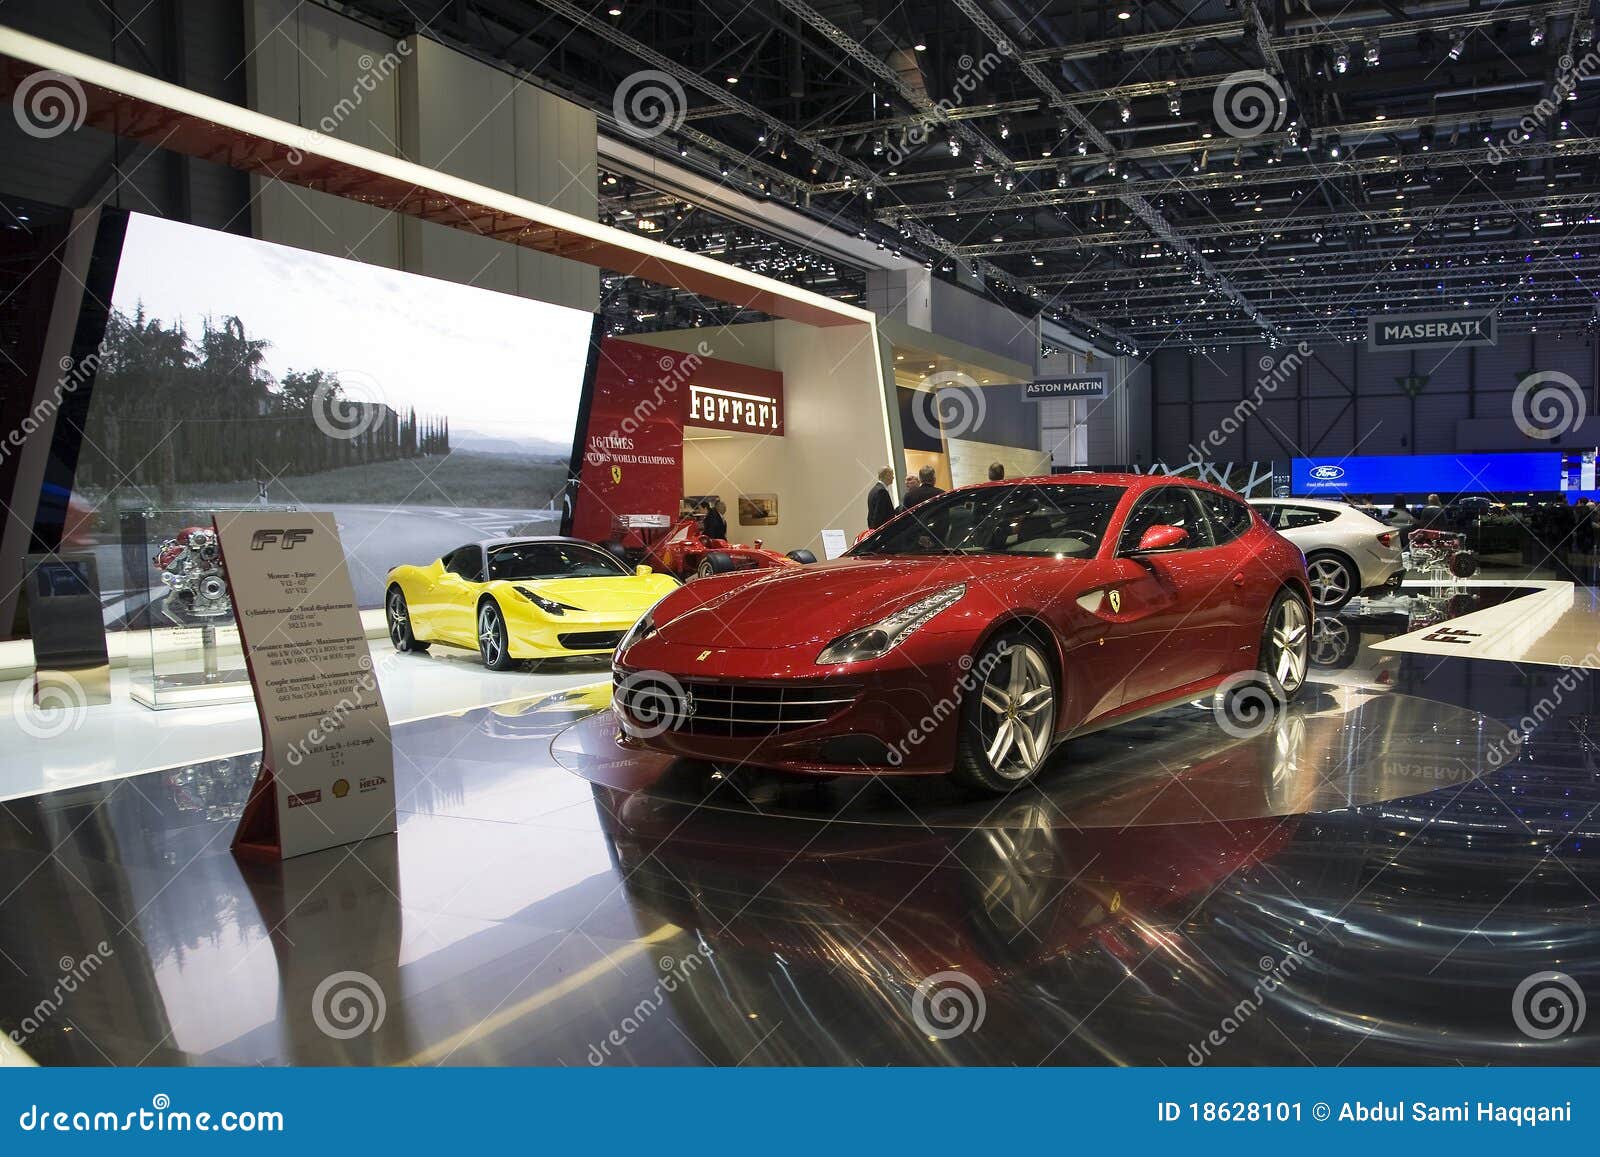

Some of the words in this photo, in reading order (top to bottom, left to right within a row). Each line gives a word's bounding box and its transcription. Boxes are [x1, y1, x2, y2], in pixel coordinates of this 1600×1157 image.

[1384, 321, 1480, 340] MASERATI
[1027, 383, 1061, 393] ASTON
[1063, 381, 1102, 392] MARTIN
[689, 384, 778, 429] Ferrari
[591, 436, 603, 448] 16
[603, 436, 634, 450] TIMES
[612, 455, 639, 464] WORLD
[638, 455, 675, 465] CHAMPIONS
[1316, 467, 1338, 477] Ford
[250, 528, 314, 551] FF
